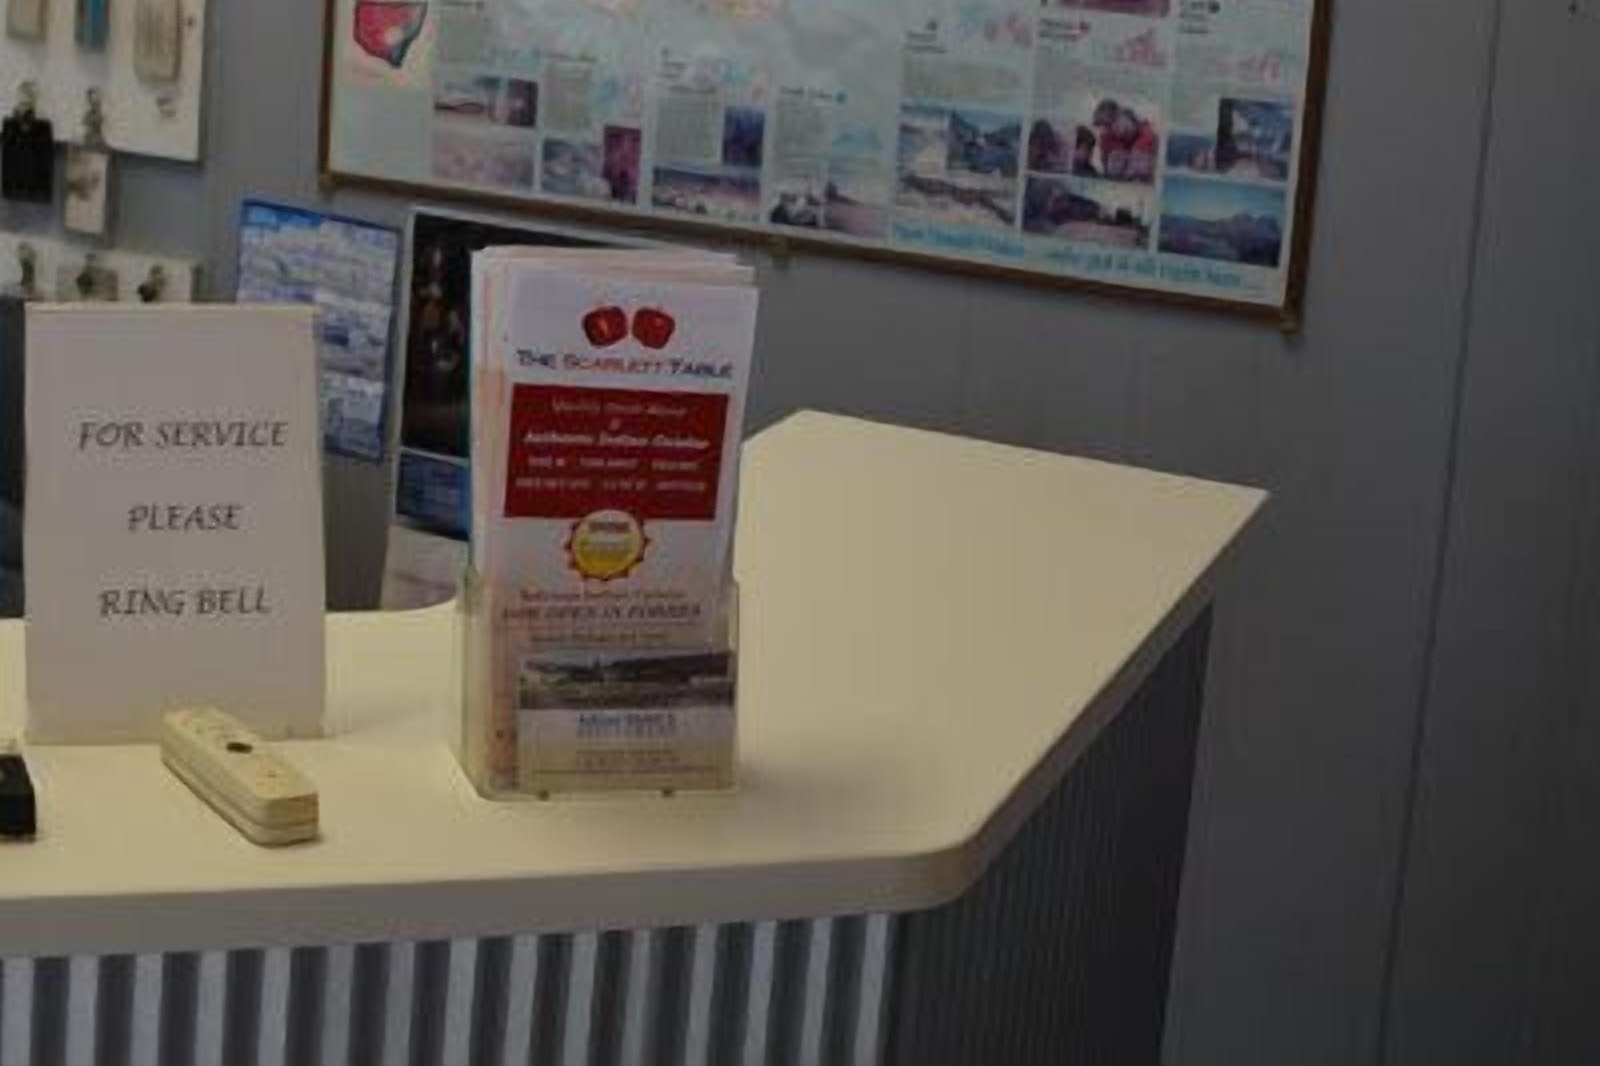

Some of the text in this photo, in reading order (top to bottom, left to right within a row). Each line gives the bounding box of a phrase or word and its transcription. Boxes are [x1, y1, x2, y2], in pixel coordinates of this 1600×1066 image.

[516, 349, 557, 370] THE
[79, 420, 289, 450] FOR SERVICE
[127, 504, 245, 531] PLEASE
[100, 585, 271, 616] RING BELL
